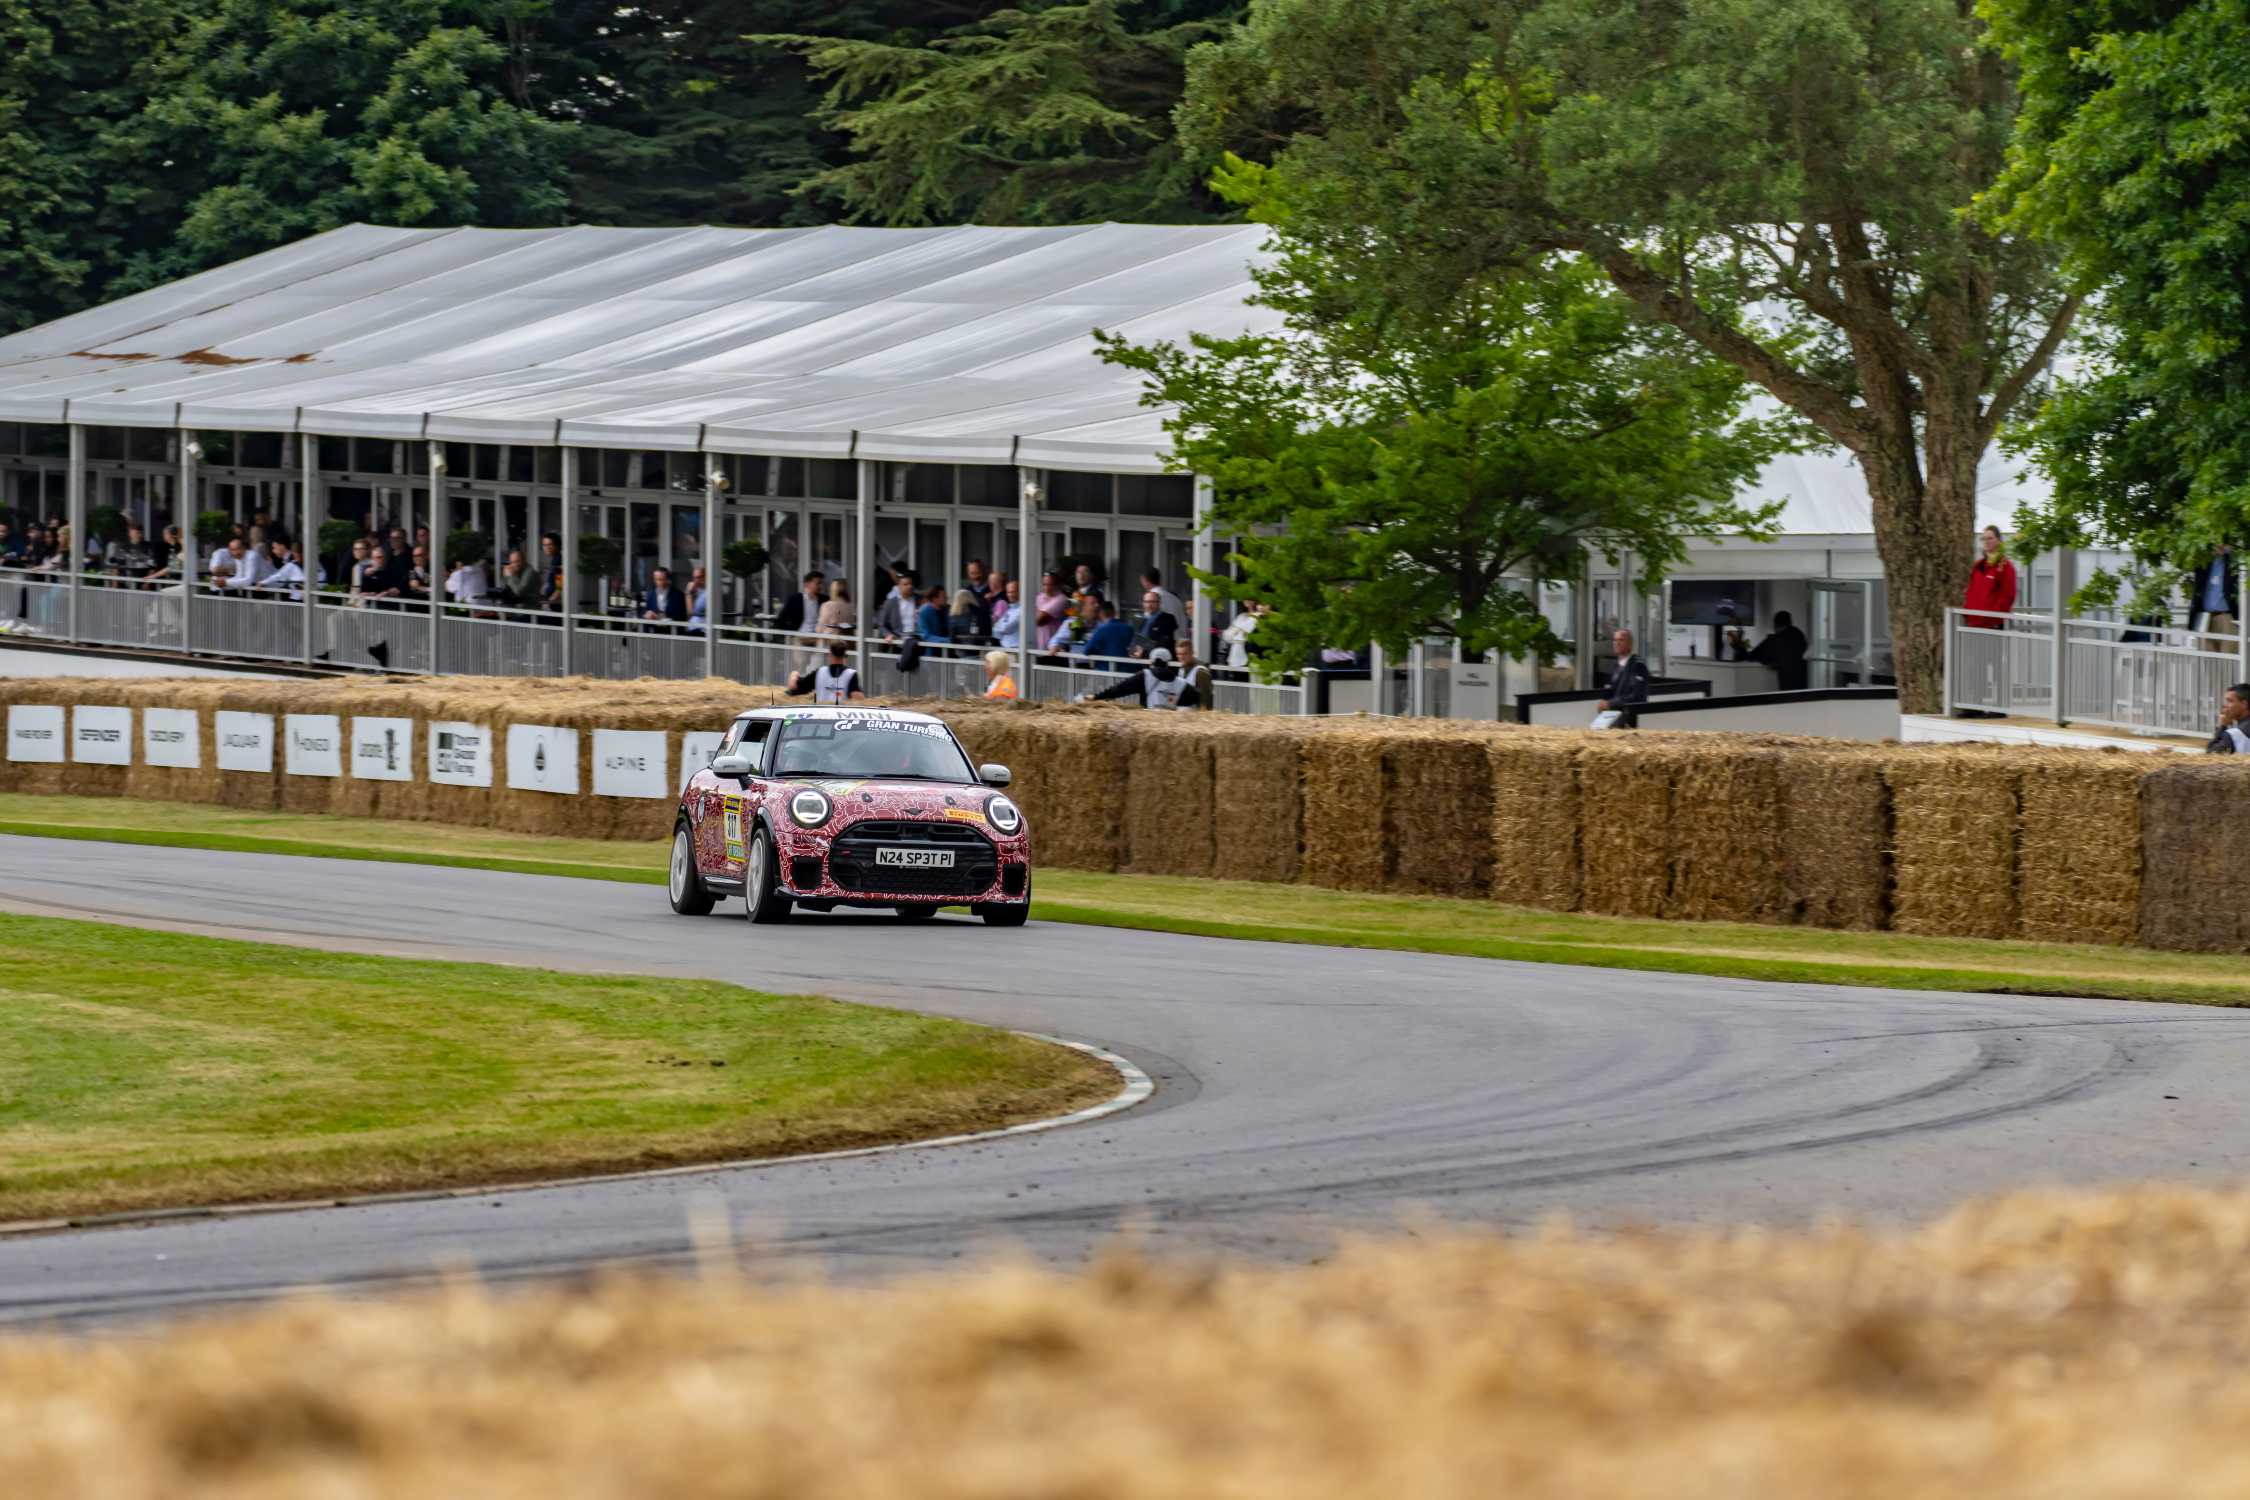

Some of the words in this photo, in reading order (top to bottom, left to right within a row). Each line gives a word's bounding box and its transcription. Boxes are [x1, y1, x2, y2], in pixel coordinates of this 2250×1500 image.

[836, 711, 892, 720] MINI
[866, 720, 900, 730] GRAN
[903, 723, 953, 742] TURISMO
[880, 851, 904, 864] N24
[906, 852, 938, 865] SP3T
